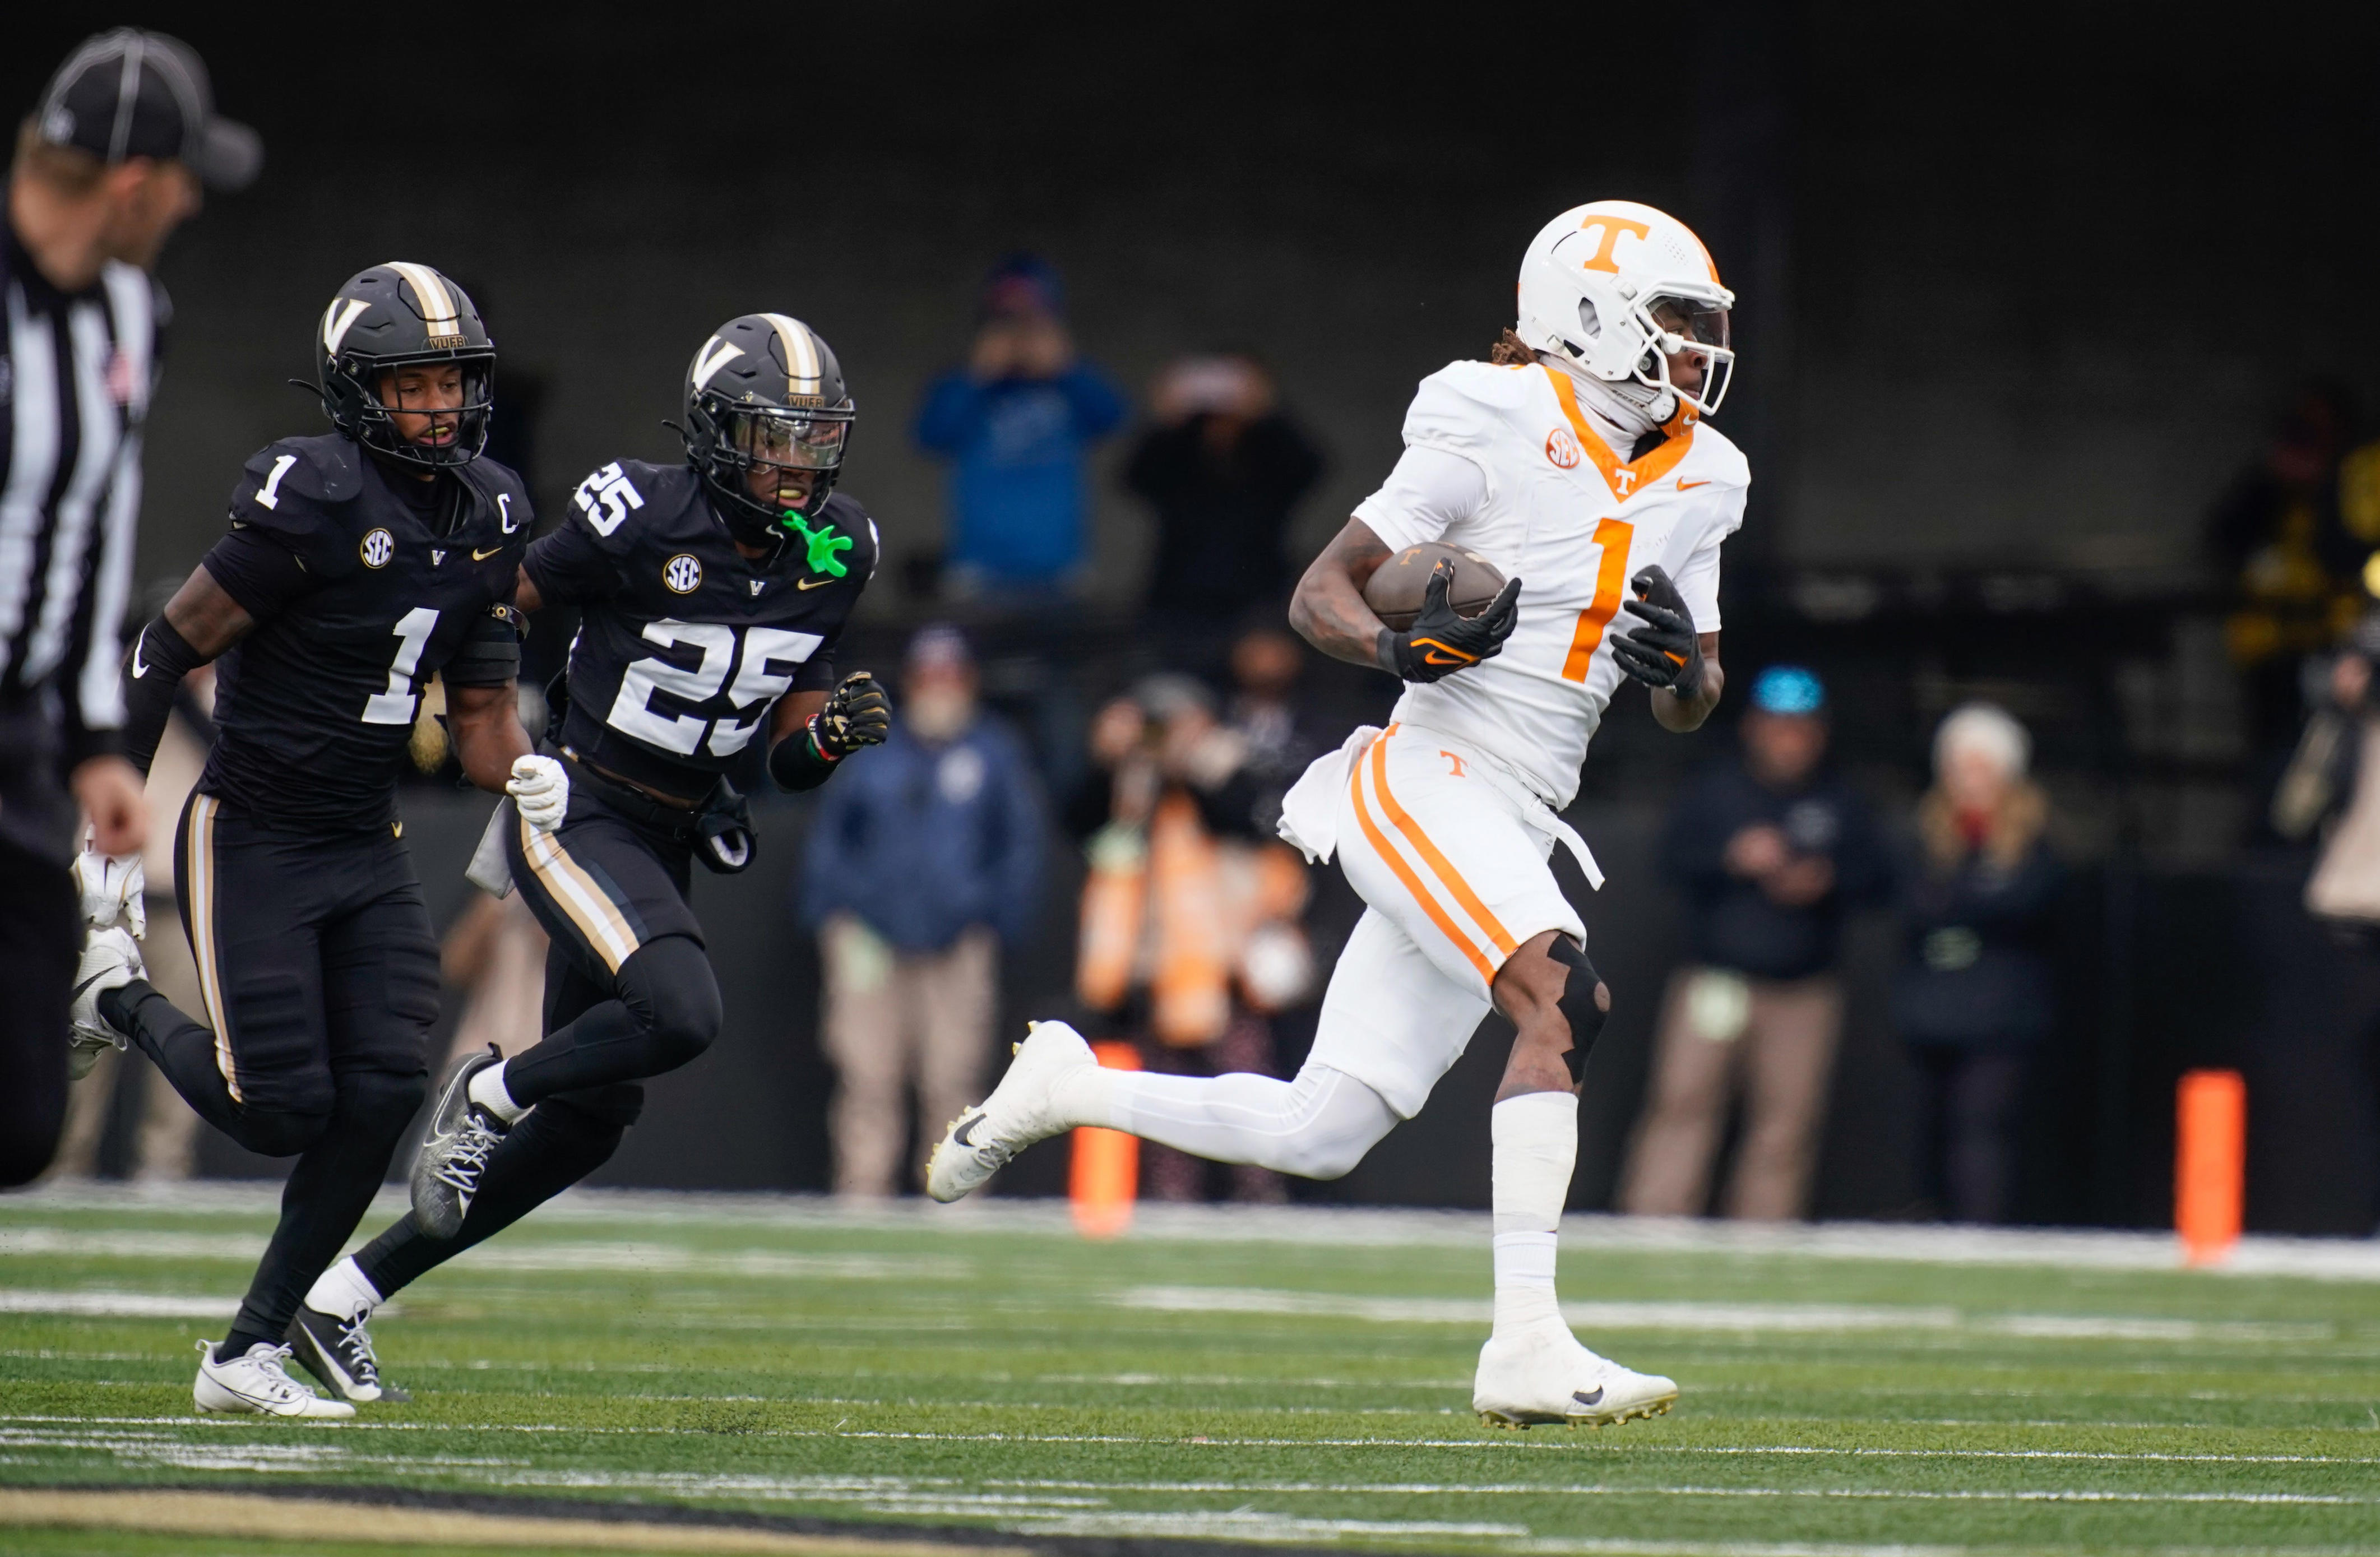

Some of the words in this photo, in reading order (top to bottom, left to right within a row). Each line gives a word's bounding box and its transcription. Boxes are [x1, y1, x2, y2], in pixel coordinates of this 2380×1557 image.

[1581, 214, 1651, 274] T
[323, 297, 372, 356] V
[429, 336, 465, 350] VUFB
[692, 334, 746, 392] V
[1549, 430, 1578, 466] SEC
[254, 455, 297, 511] 1
[574, 461, 645, 537] 25
[1615, 468, 1636, 495] T
[364, 530, 392, 567] SEC
[432, 549, 446, 566] V
[1399, 549, 1422, 566] T
[667, 557, 700, 591] SEC
[749, 580, 766, 596] V
[1561, 517, 1635, 684] 1
[362, 607, 440, 725] 1
[607, 617, 825, 758] 25
[1439, 749, 1469, 778] T
